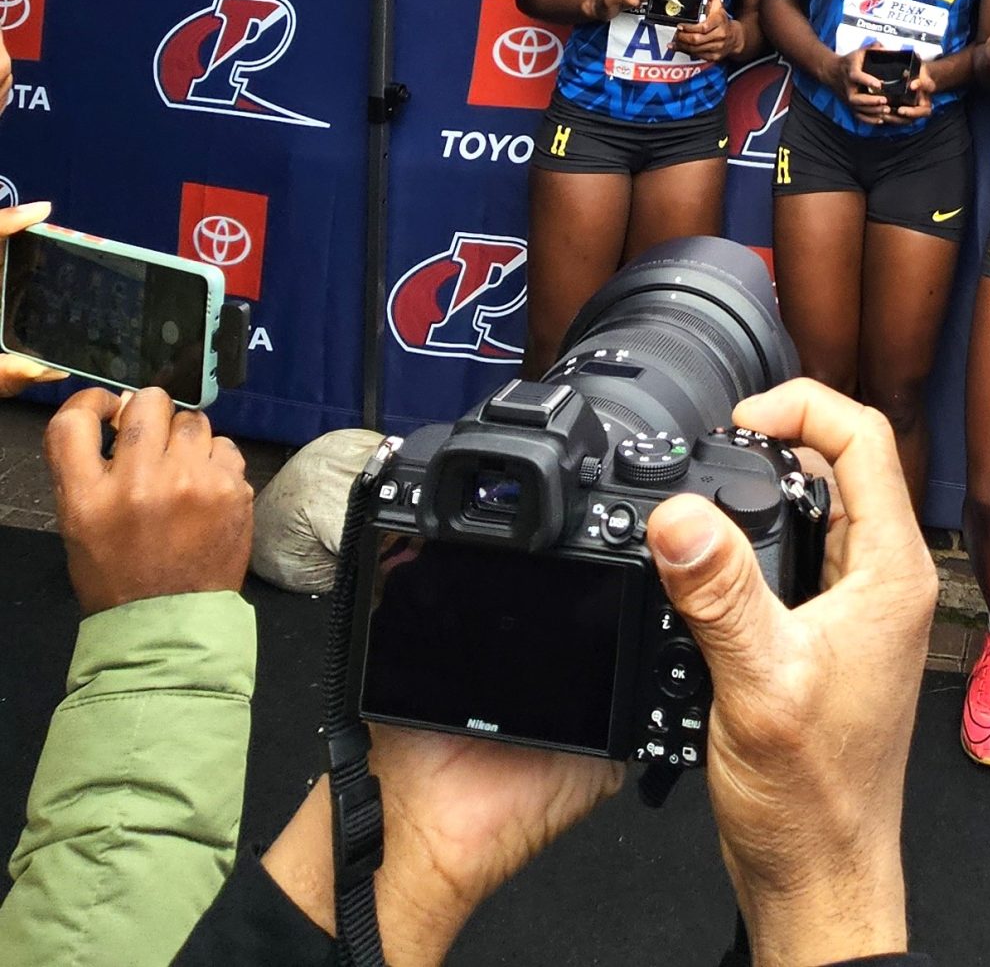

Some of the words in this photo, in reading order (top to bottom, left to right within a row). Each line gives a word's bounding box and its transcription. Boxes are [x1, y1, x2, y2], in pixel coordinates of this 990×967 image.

[890, 0, 926, 15] PENN
[856, 18, 883, 31] Dream
[441, 130, 535, 163] TOYO
[551, 124, 571, 157] H
[777, 147, 791, 184] H
[671, 669, 685, 679] OK
[467, 718, 498, 732] Nikon
[682, 718, 701, 729] MENU
